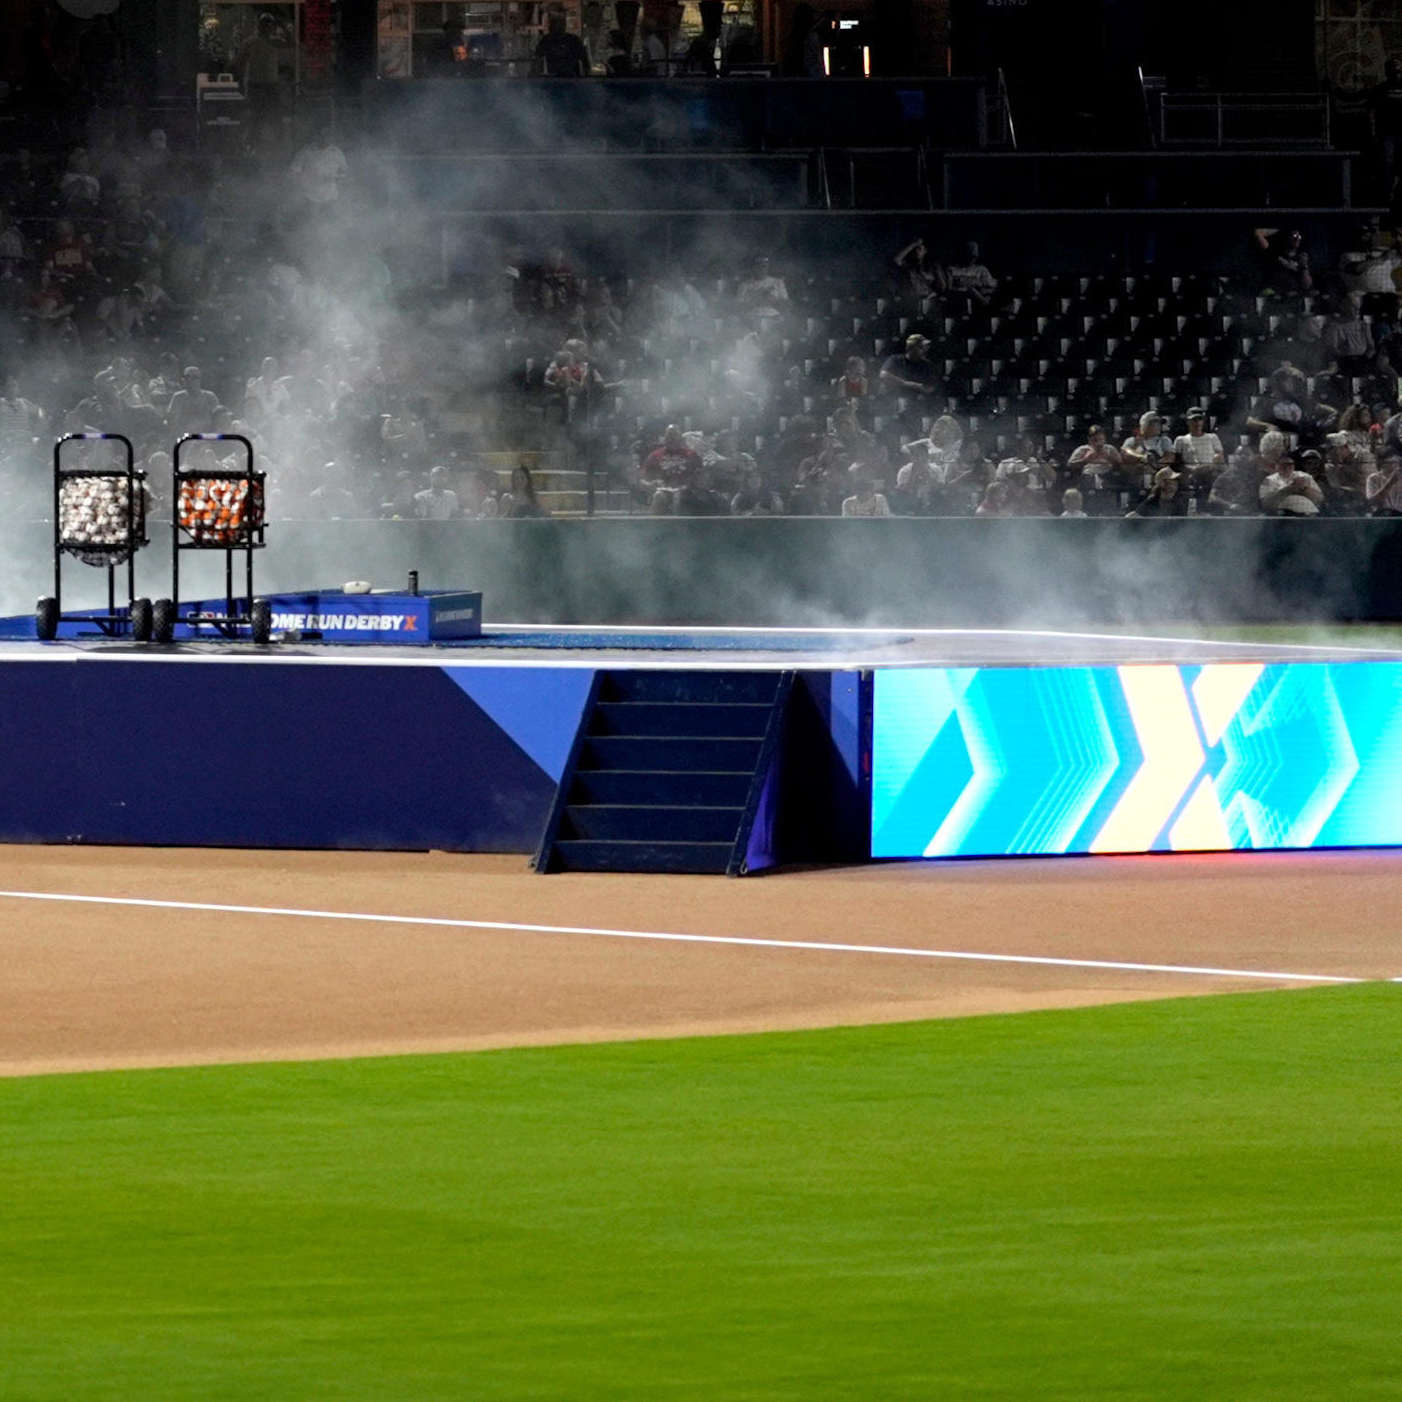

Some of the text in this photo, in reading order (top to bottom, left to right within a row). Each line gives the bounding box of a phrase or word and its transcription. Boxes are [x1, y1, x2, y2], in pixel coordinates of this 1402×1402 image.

[270, 613, 305, 630] OME
[306, 614, 345, 630] RUN
[345, 615, 404, 631] DERBY
[403, 615, 417, 631] X
